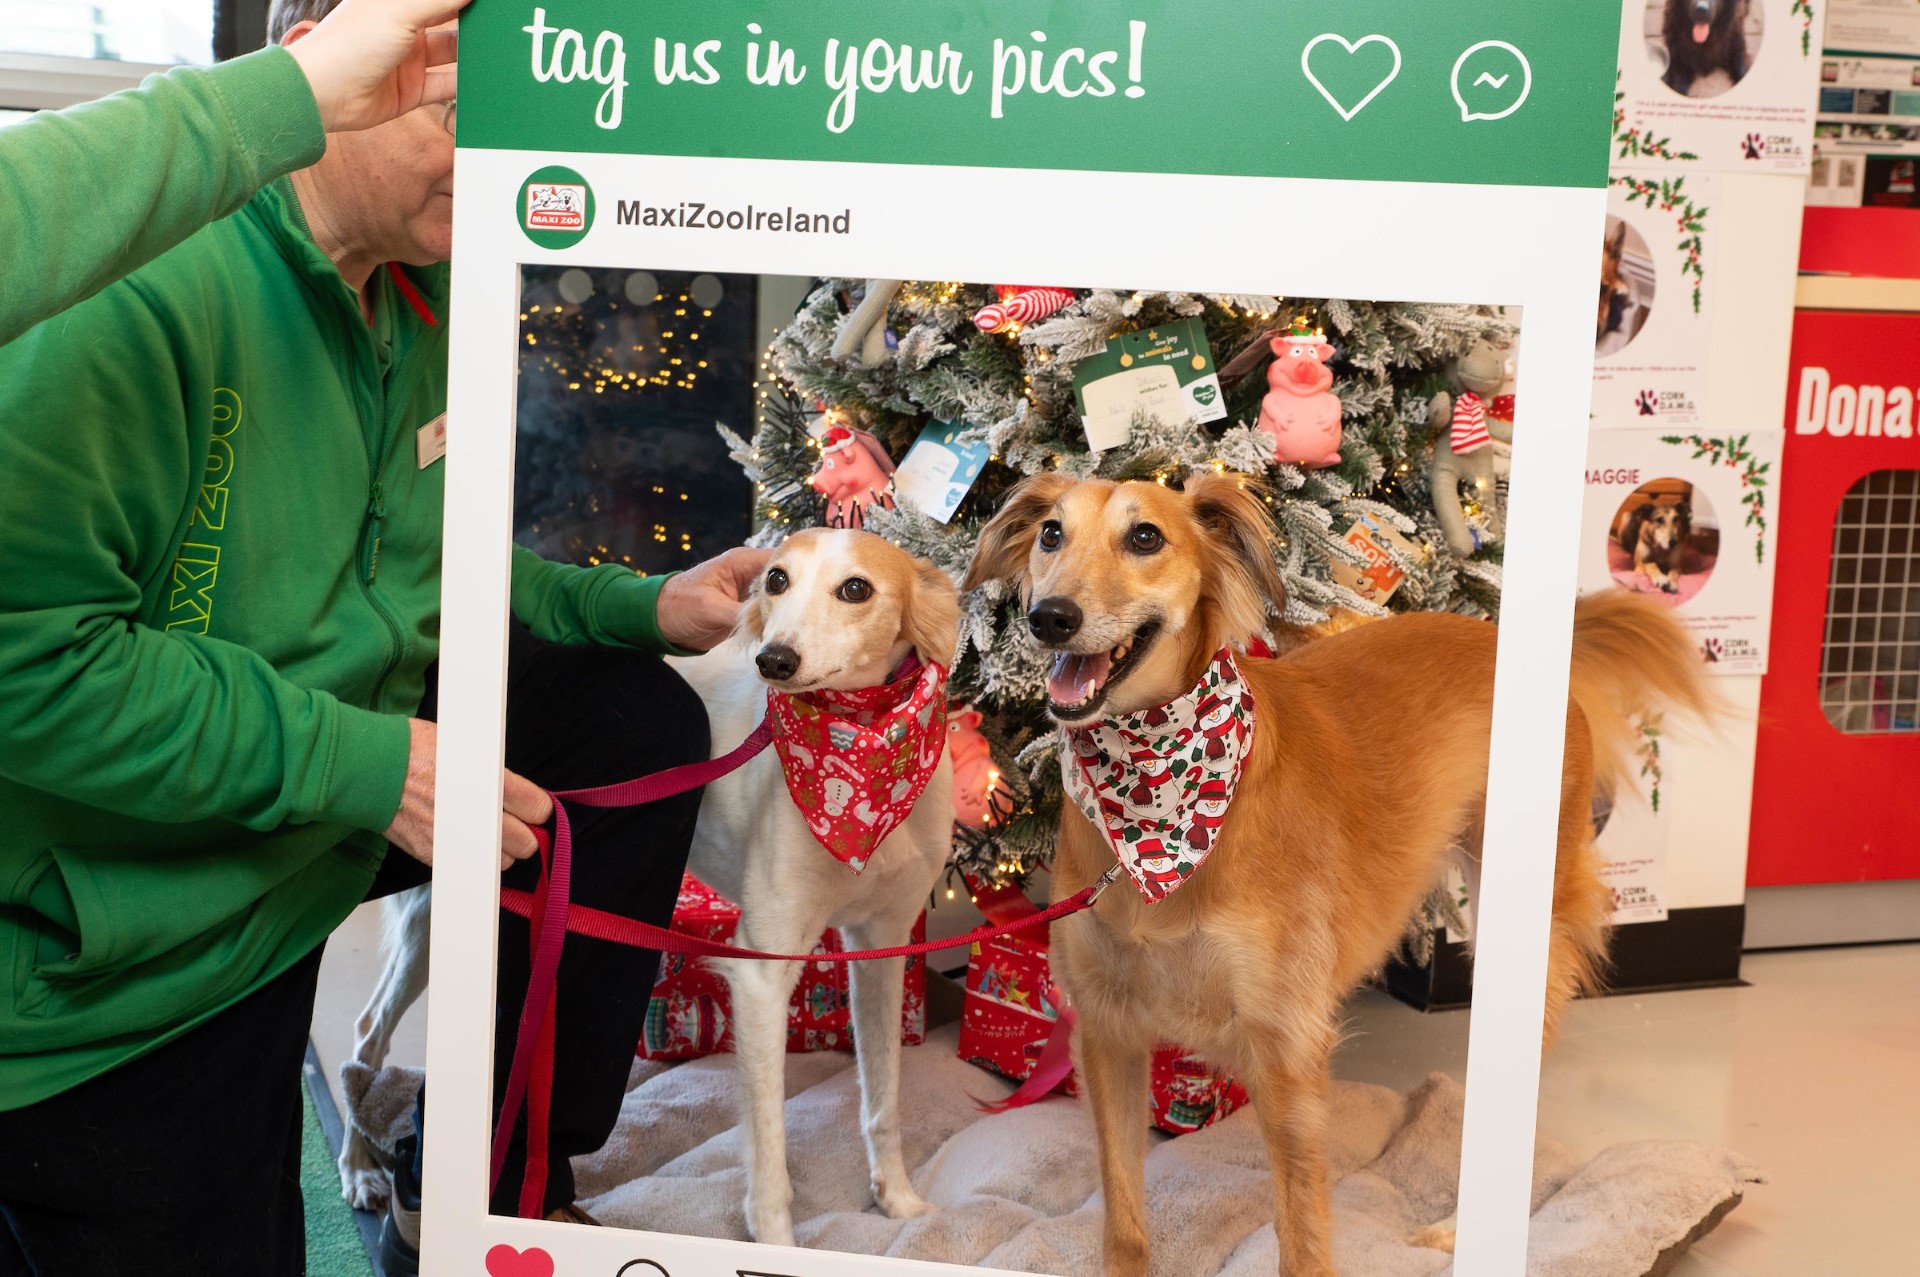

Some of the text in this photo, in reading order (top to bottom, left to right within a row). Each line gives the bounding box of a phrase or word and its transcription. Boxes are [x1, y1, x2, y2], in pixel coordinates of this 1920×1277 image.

[523, 7, 1147, 134] tag us in your pics!
[532, 215, 581, 225] MAXI ZOO
[616, 199, 850, 234] MaxiZooIreland
[1795, 366, 1920, 439] Dona
[189, 386, 243, 531] ZOO
